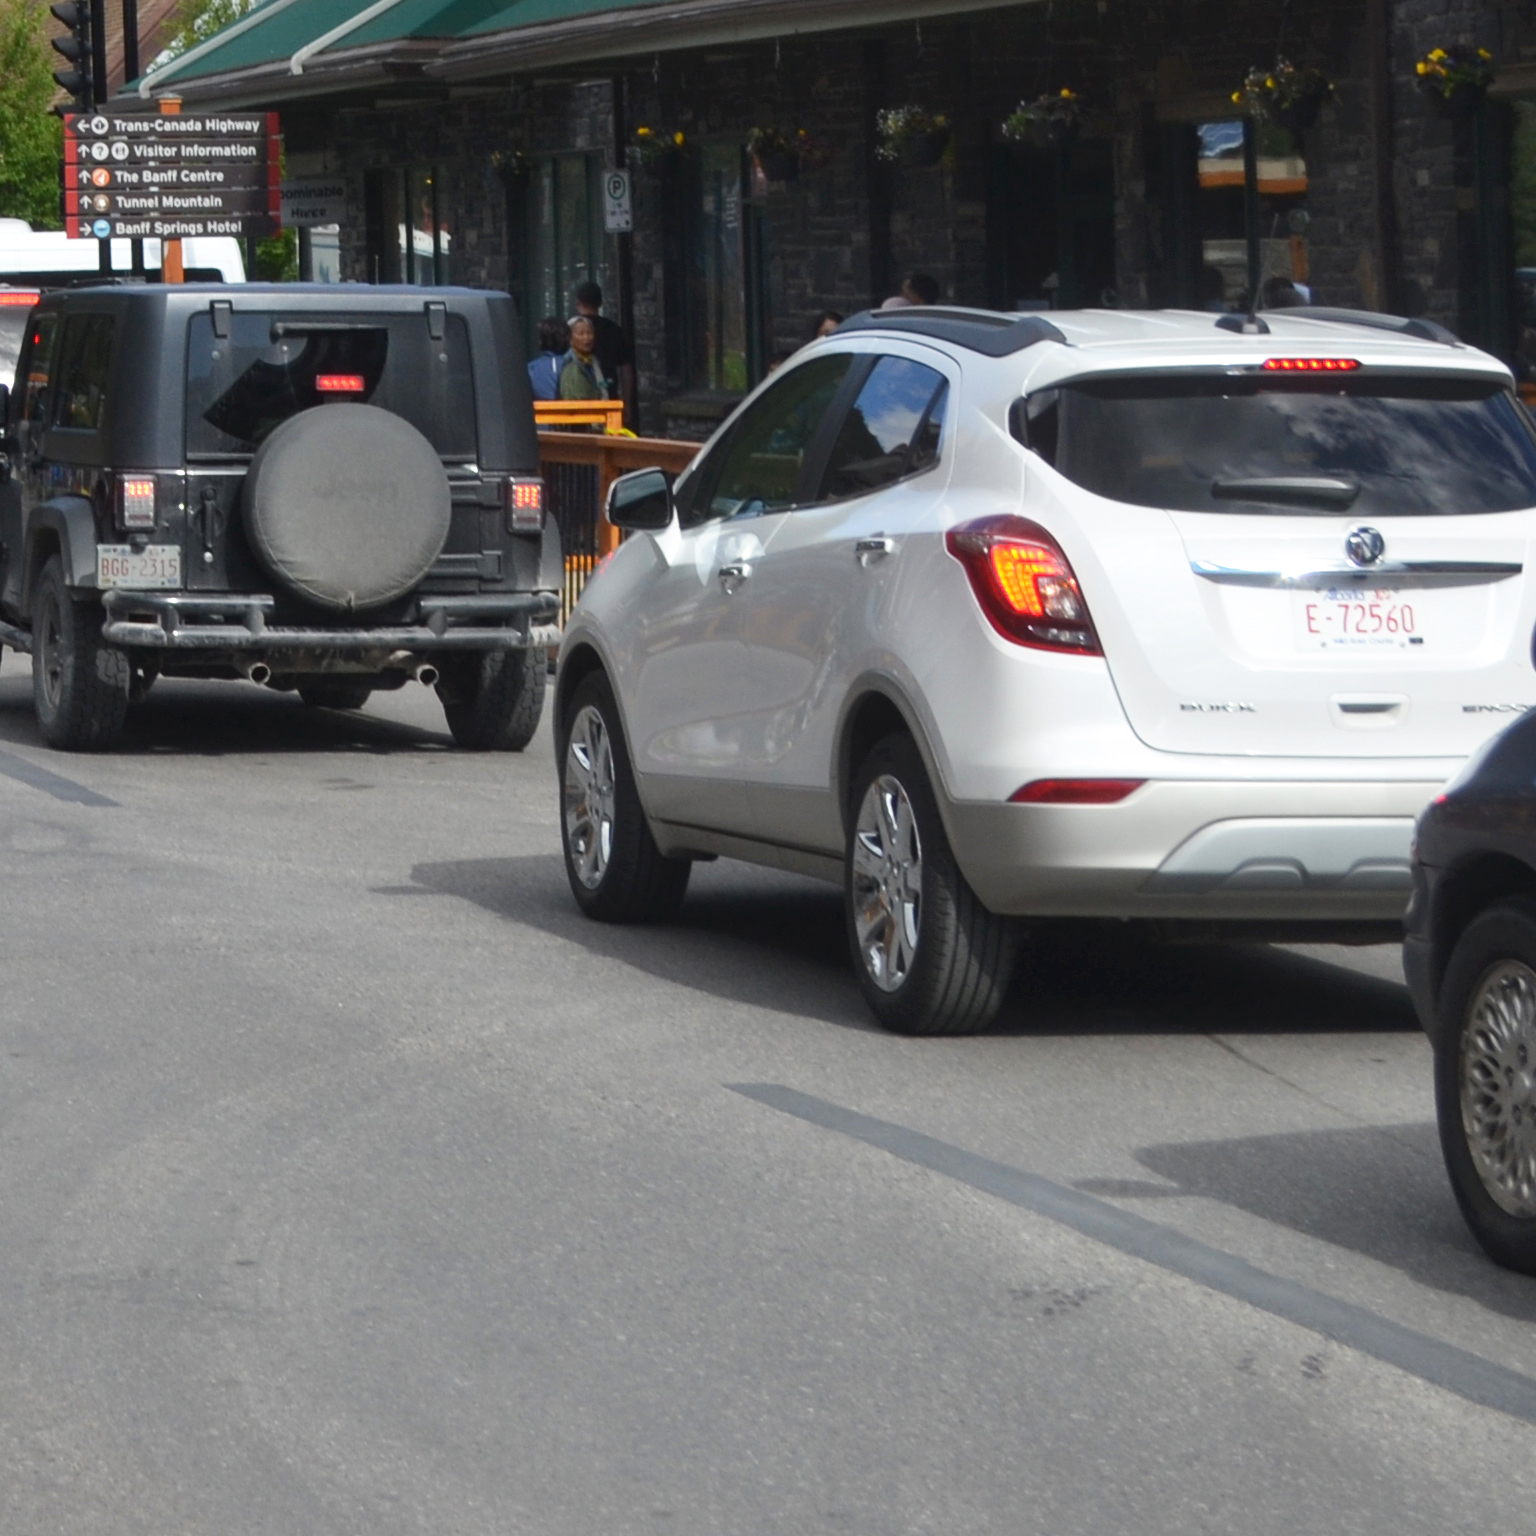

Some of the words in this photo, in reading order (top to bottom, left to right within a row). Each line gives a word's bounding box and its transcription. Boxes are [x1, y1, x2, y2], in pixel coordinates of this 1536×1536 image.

[113, 118, 202, 132] Trans-Canada
[205, 118, 260, 134] Highway
[133, 145, 177, 157] Visitor
[181, 144, 256, 157] Information
[115, 170, 139, 183] The
[142, 169, 178, 183] Banff
[180, 169, 225, 182] Centre
[115, 195, 159, 208] Tunnel
[162, 194, 222, 208] Mountain
[115, 221, 151, 235] Banff
[154, 220, 204, 237] Springs
[207, 220, 242, 233] Hotel
[101, 558, 178, 577] BGG-2315
[1306, 604, 1414, 633] E-72560
[1179, 702, 1257, 713] BUICK
